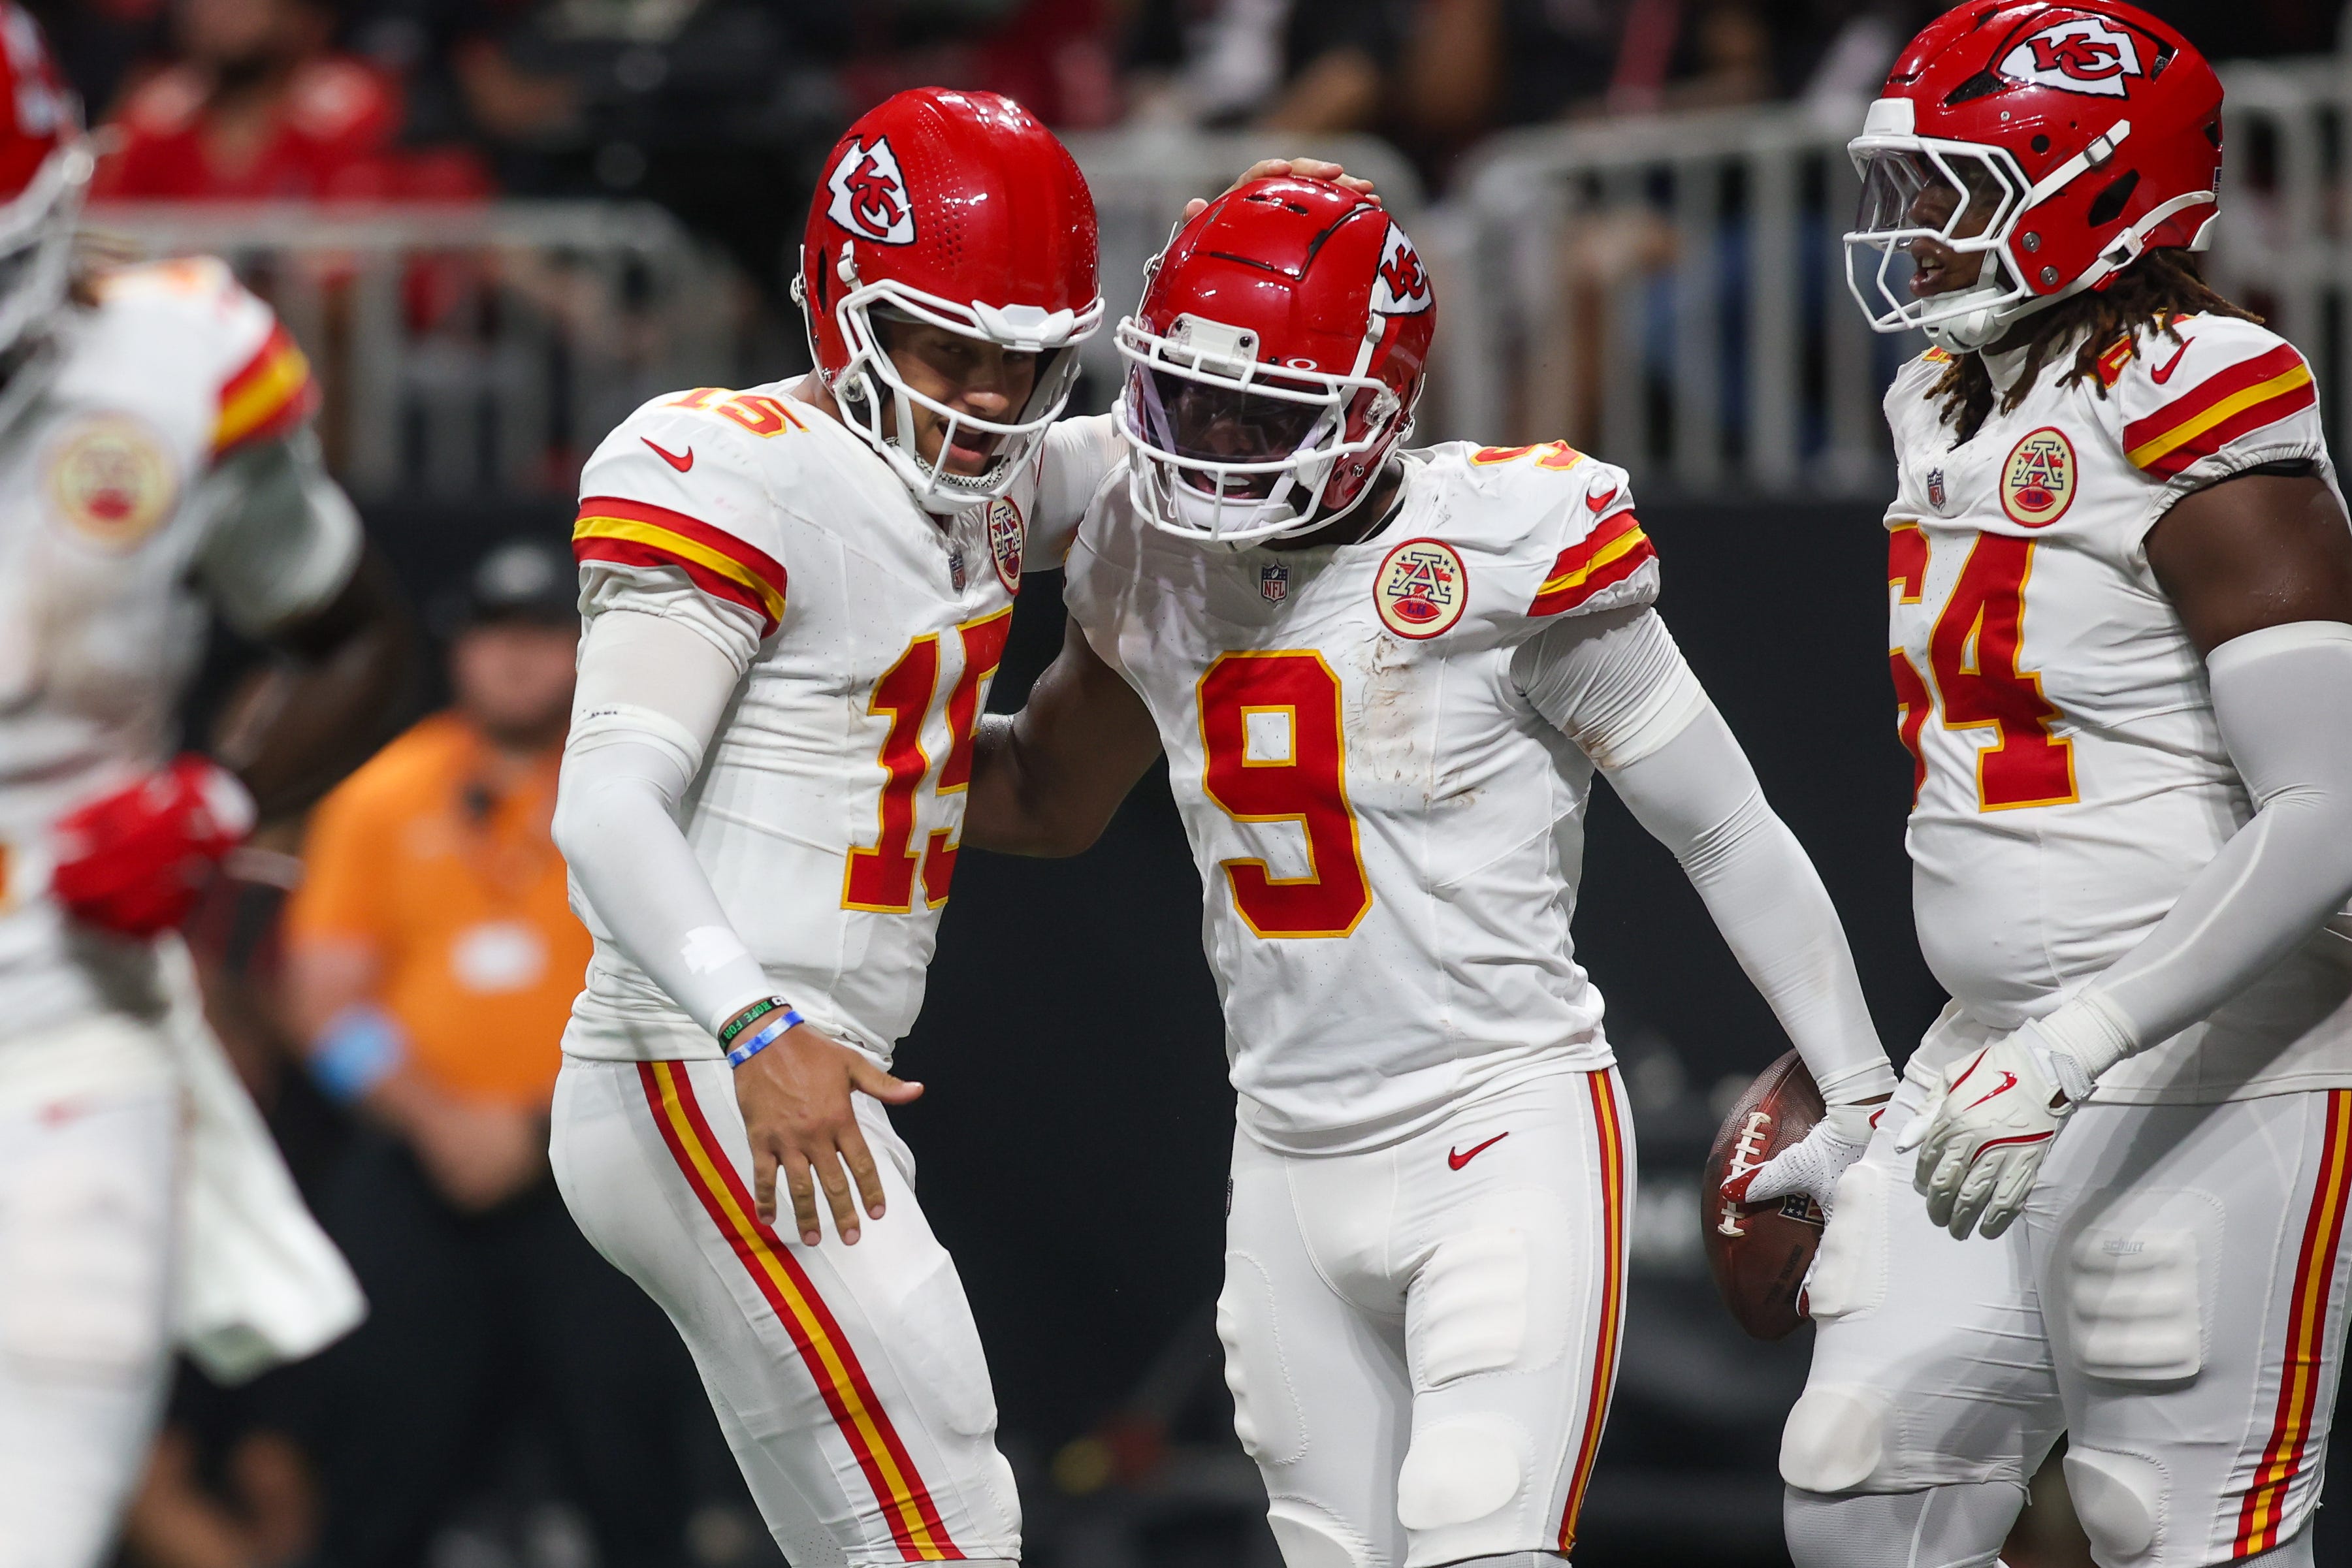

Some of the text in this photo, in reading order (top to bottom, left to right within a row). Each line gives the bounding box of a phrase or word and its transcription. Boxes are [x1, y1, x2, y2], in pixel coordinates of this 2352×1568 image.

[2026, 33, 2124, 81] KC
[844, 155, 905, 237] KC
[1379, 244, 1426, 303] KC
[657, 387, 810, 439] 15
[2011, 441, 2064, 490] A
[993, 506, 1021, 560] A
[1264, 581, 1285, 598] NFL
[1387, 551, 1451, 605] A
[841, 604, 1014, 914] 15
[1195, 649, 1373, 938] 9
